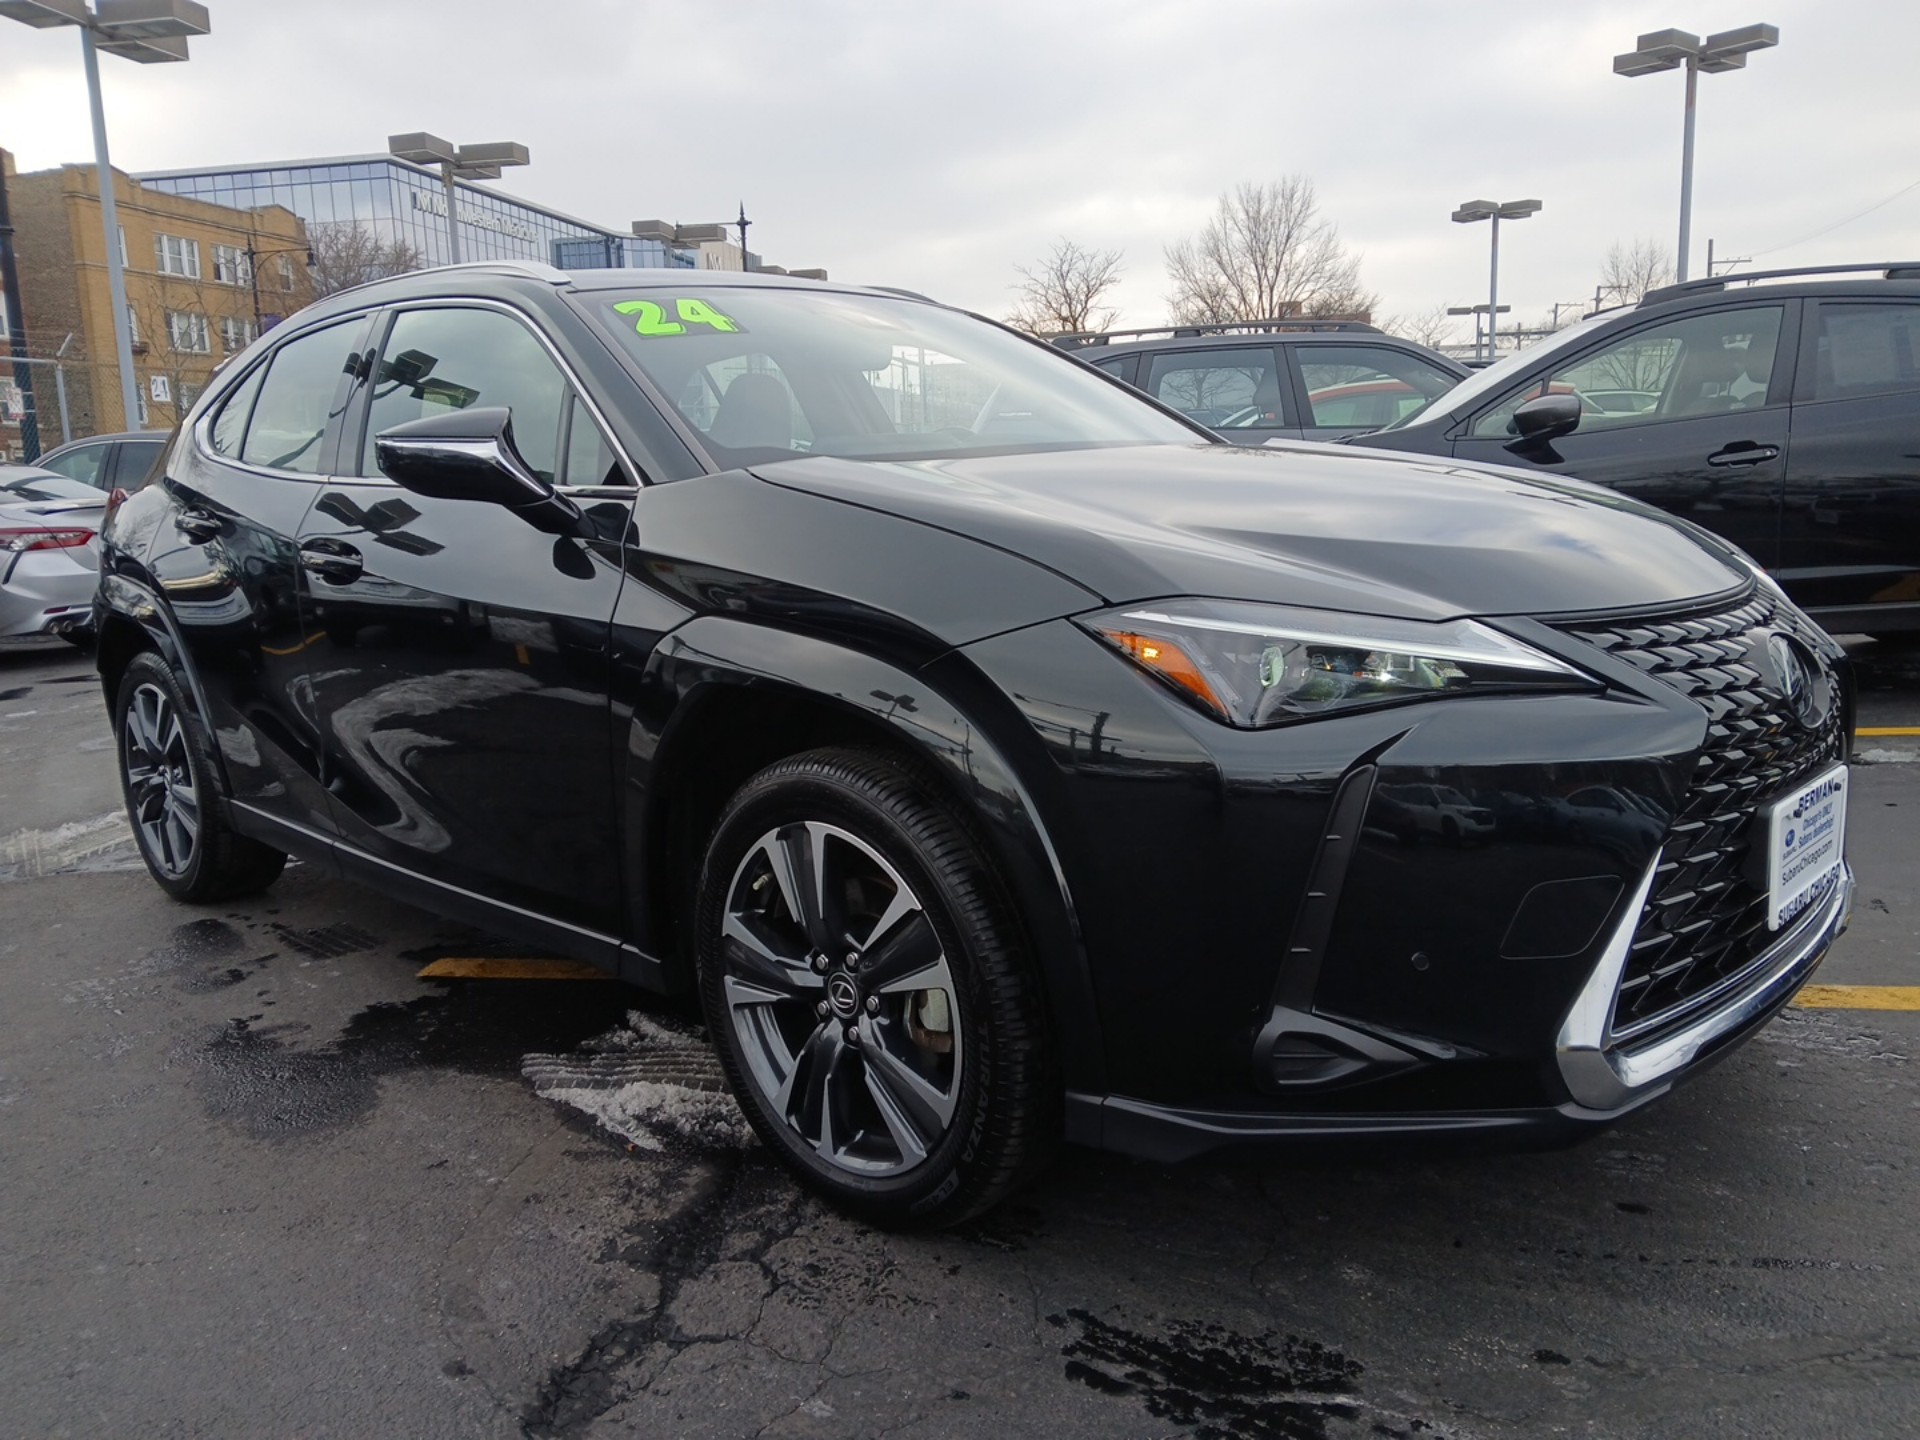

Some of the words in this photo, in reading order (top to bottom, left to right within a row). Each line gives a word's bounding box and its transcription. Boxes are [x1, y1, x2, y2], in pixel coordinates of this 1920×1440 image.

[433, 197, 502, 232] Nohwestern
[502, 219, 539, 244] Medicine
[613, 299, 738, 336] 24
[1799, 779, 1833, 811] BERMAN
[1782, 839, 1833, 887] SubaruChicago.com
[1778, 888, 1810, 926] SUBARU
[961, 1021, 991, 1162] TURANZA
